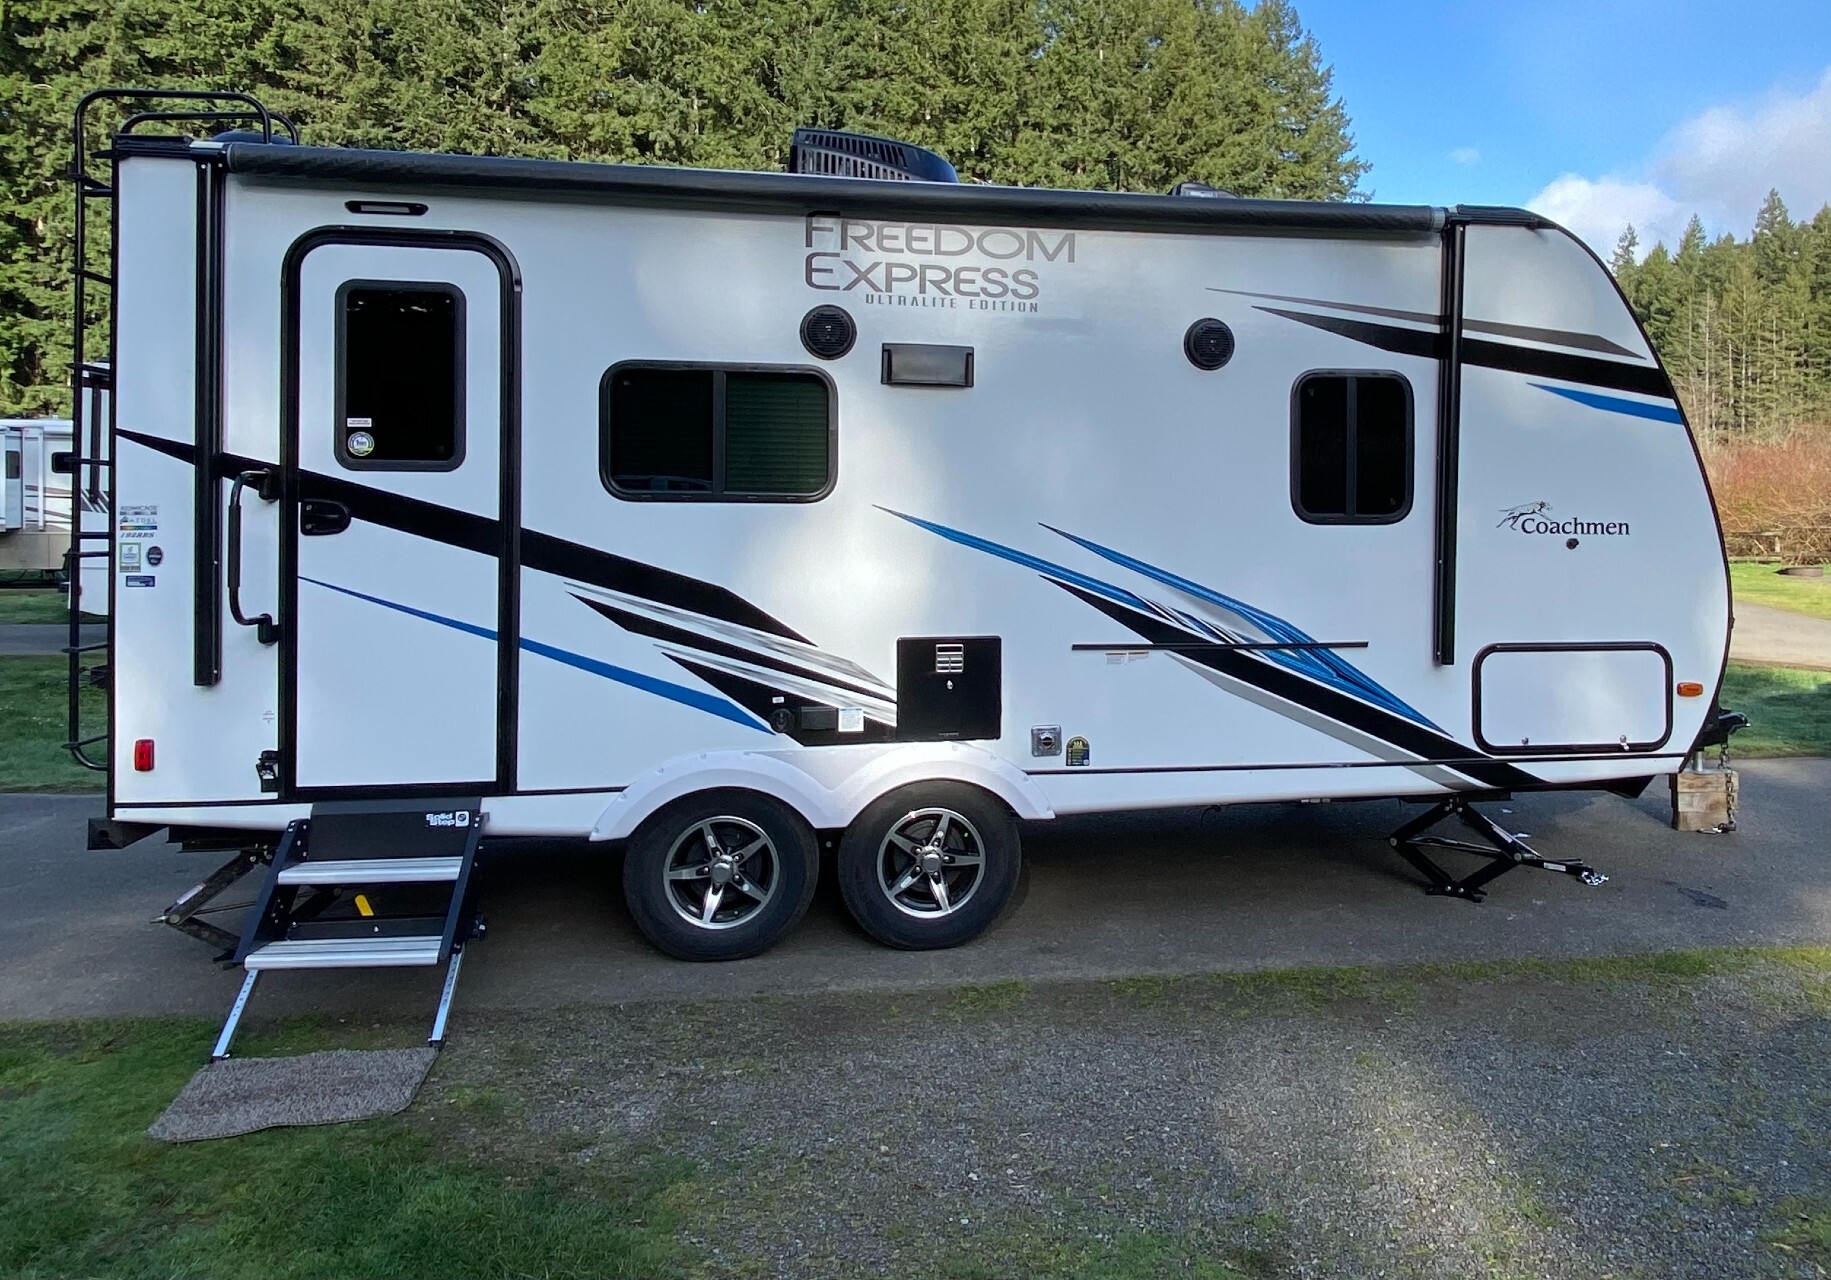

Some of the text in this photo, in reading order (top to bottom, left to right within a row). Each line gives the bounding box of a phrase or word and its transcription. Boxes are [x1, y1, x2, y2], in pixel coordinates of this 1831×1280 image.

[805, 210, 1076, 263] FREEDOM
[805, 252, 1040, 300] EXPRESS
[865, 293, 1038, 313] ULTRALITE EDITION
[1521, 517, 1630, 536] Coachmen
